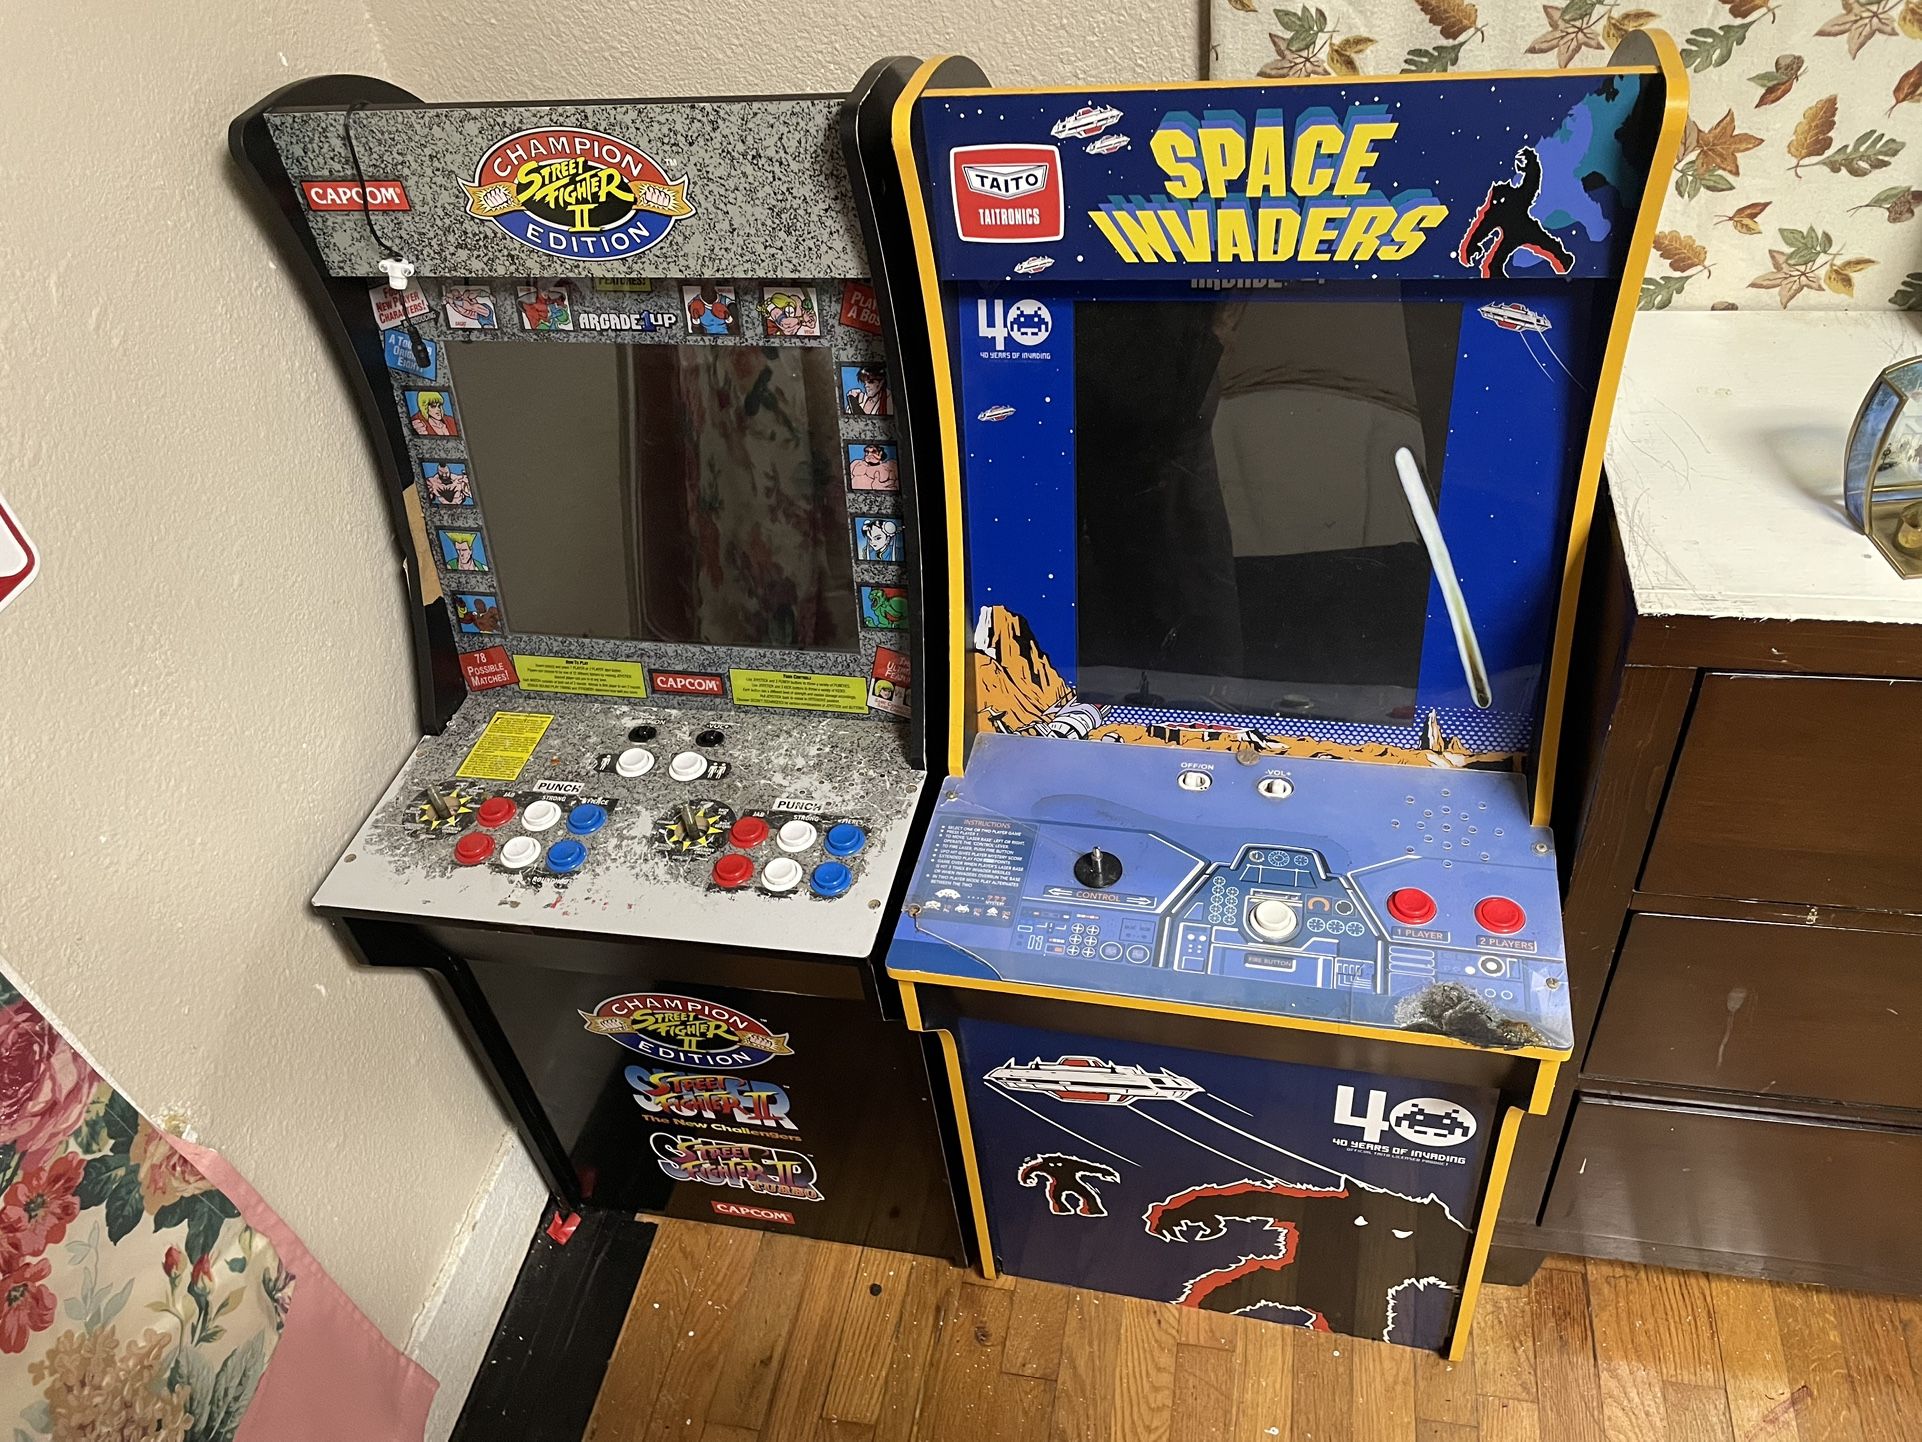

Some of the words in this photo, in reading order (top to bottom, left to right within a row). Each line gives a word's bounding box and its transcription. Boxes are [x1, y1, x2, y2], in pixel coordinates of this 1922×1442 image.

[493, 137, 643, 177] CHAMPION
[1150, 122, 1399, 198] SPACE
[517, 157, 586, 202] STREET
[533, 168, 635, 209] FIGHTER
[975, 173, 1039, 193] TAITO
[310, 187, 396, 205] CAPCOM
[978, 207, 1040, 225] TAITRONICS
[526, 222, 650, 253] EDITION
[1088, 204, 1449, 264] INVADERS
[1022, 352, 1051, 360] INVADING
[474, 653, 487, 663] 78
[657, 676, 716, 691] CAPCOM
[1180, 762, 1214, 770] OFF/ON
[537, 782, 581, 793] PUNCH
[777, 801, 824, 811] PUNCH
[1076, 891, 1120, 902] CONTROL
[1406, 930, 1443, 940] PLAYER
[1480, 937, 1486, 945] 2
[1489, 938, 1534, 950] PLAYERS
[611, 999, 749, 1029] CHAMPION
[631, 1009, 696, 1029] STREET
[646, 1020, 739, 1041] FIGHTER
[639, 1040, 752, 1065] EDITION
[642, 1114, 670, 1124] The
[672, 1117, 707, 1129] New
[711, 1123, 802, 1142] Challengers
[1332, 1138, 1348, 1147] 40
[1350, 1141, 1390, 1153] YEARS
[1392, 1147, 1409, 1156] OF
[1410, 1149, 1467, 1165] INVADING
[716, 1203, 786, 1221] CAPCOM
